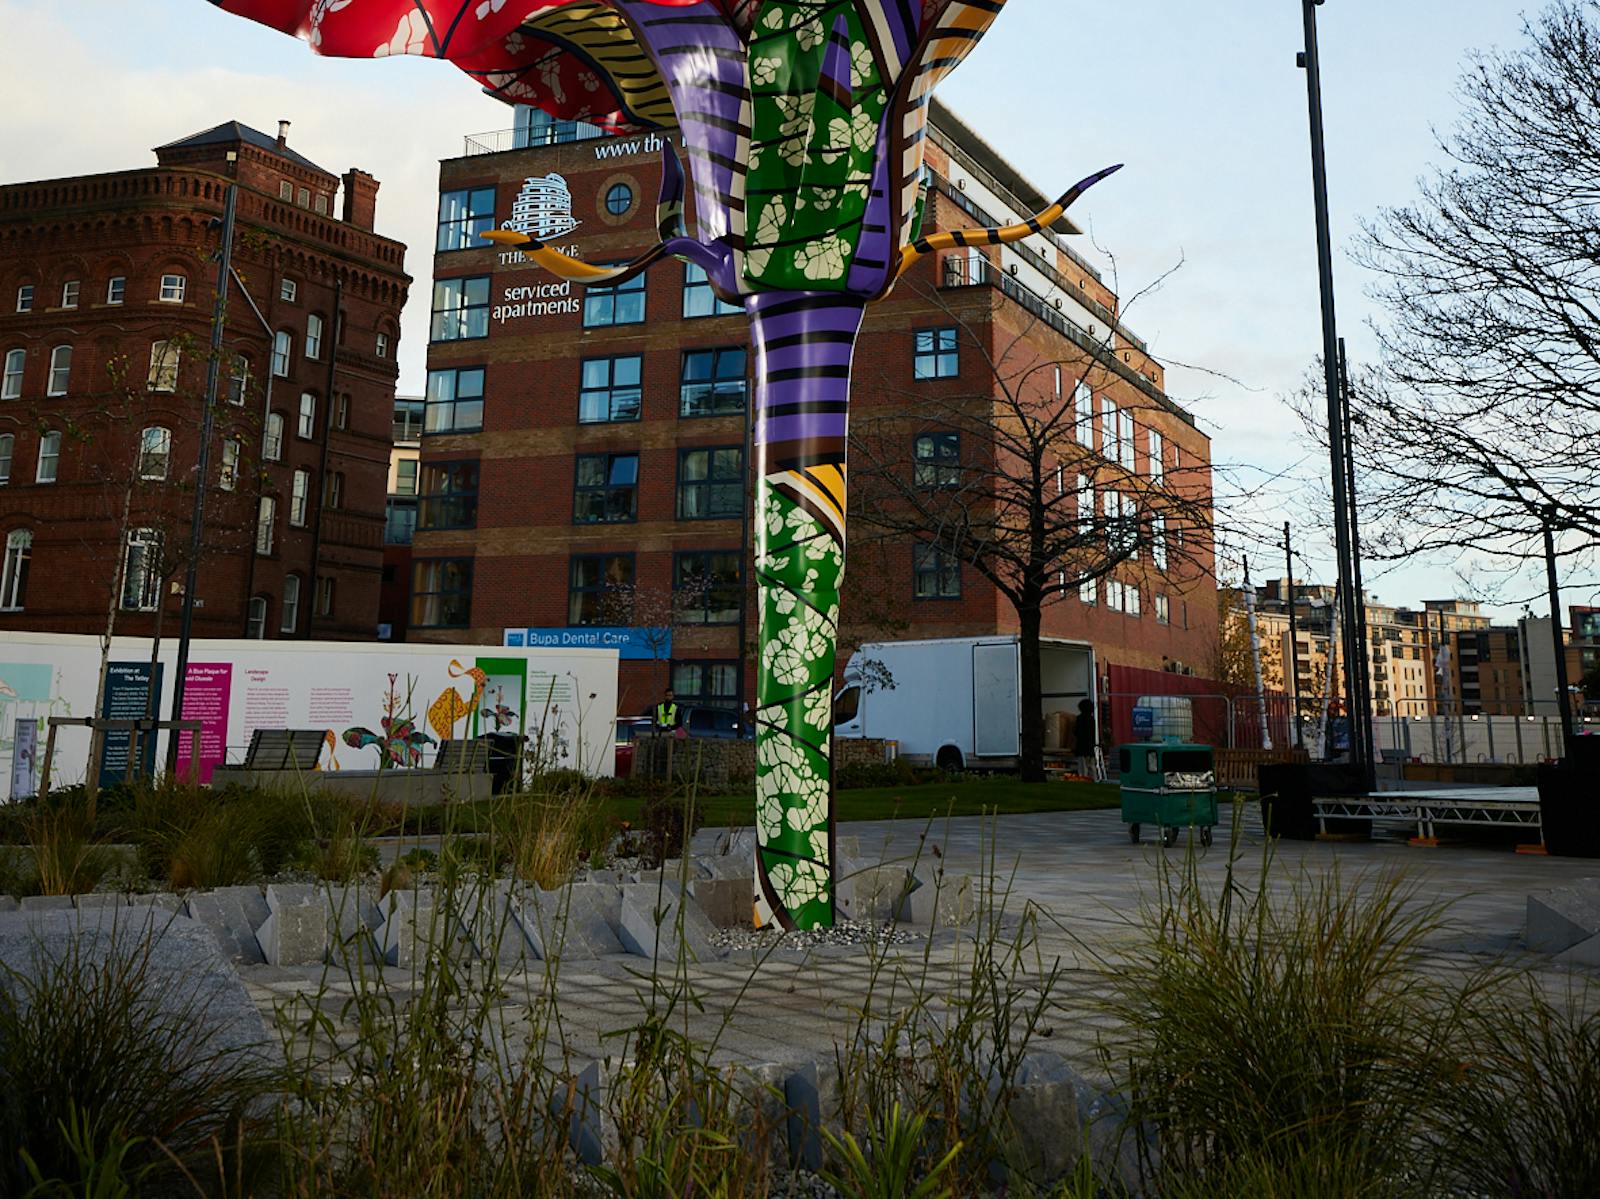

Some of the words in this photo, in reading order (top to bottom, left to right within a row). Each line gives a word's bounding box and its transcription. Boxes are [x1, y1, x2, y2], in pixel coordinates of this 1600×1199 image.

[504, 279, 571, 302] serviced
[492, 297, 581, 325] apartments
[530, 632, 559, 646] Bupa
[562, 631, 600, 645] Dental
[603, 631, 630, 645] Care
